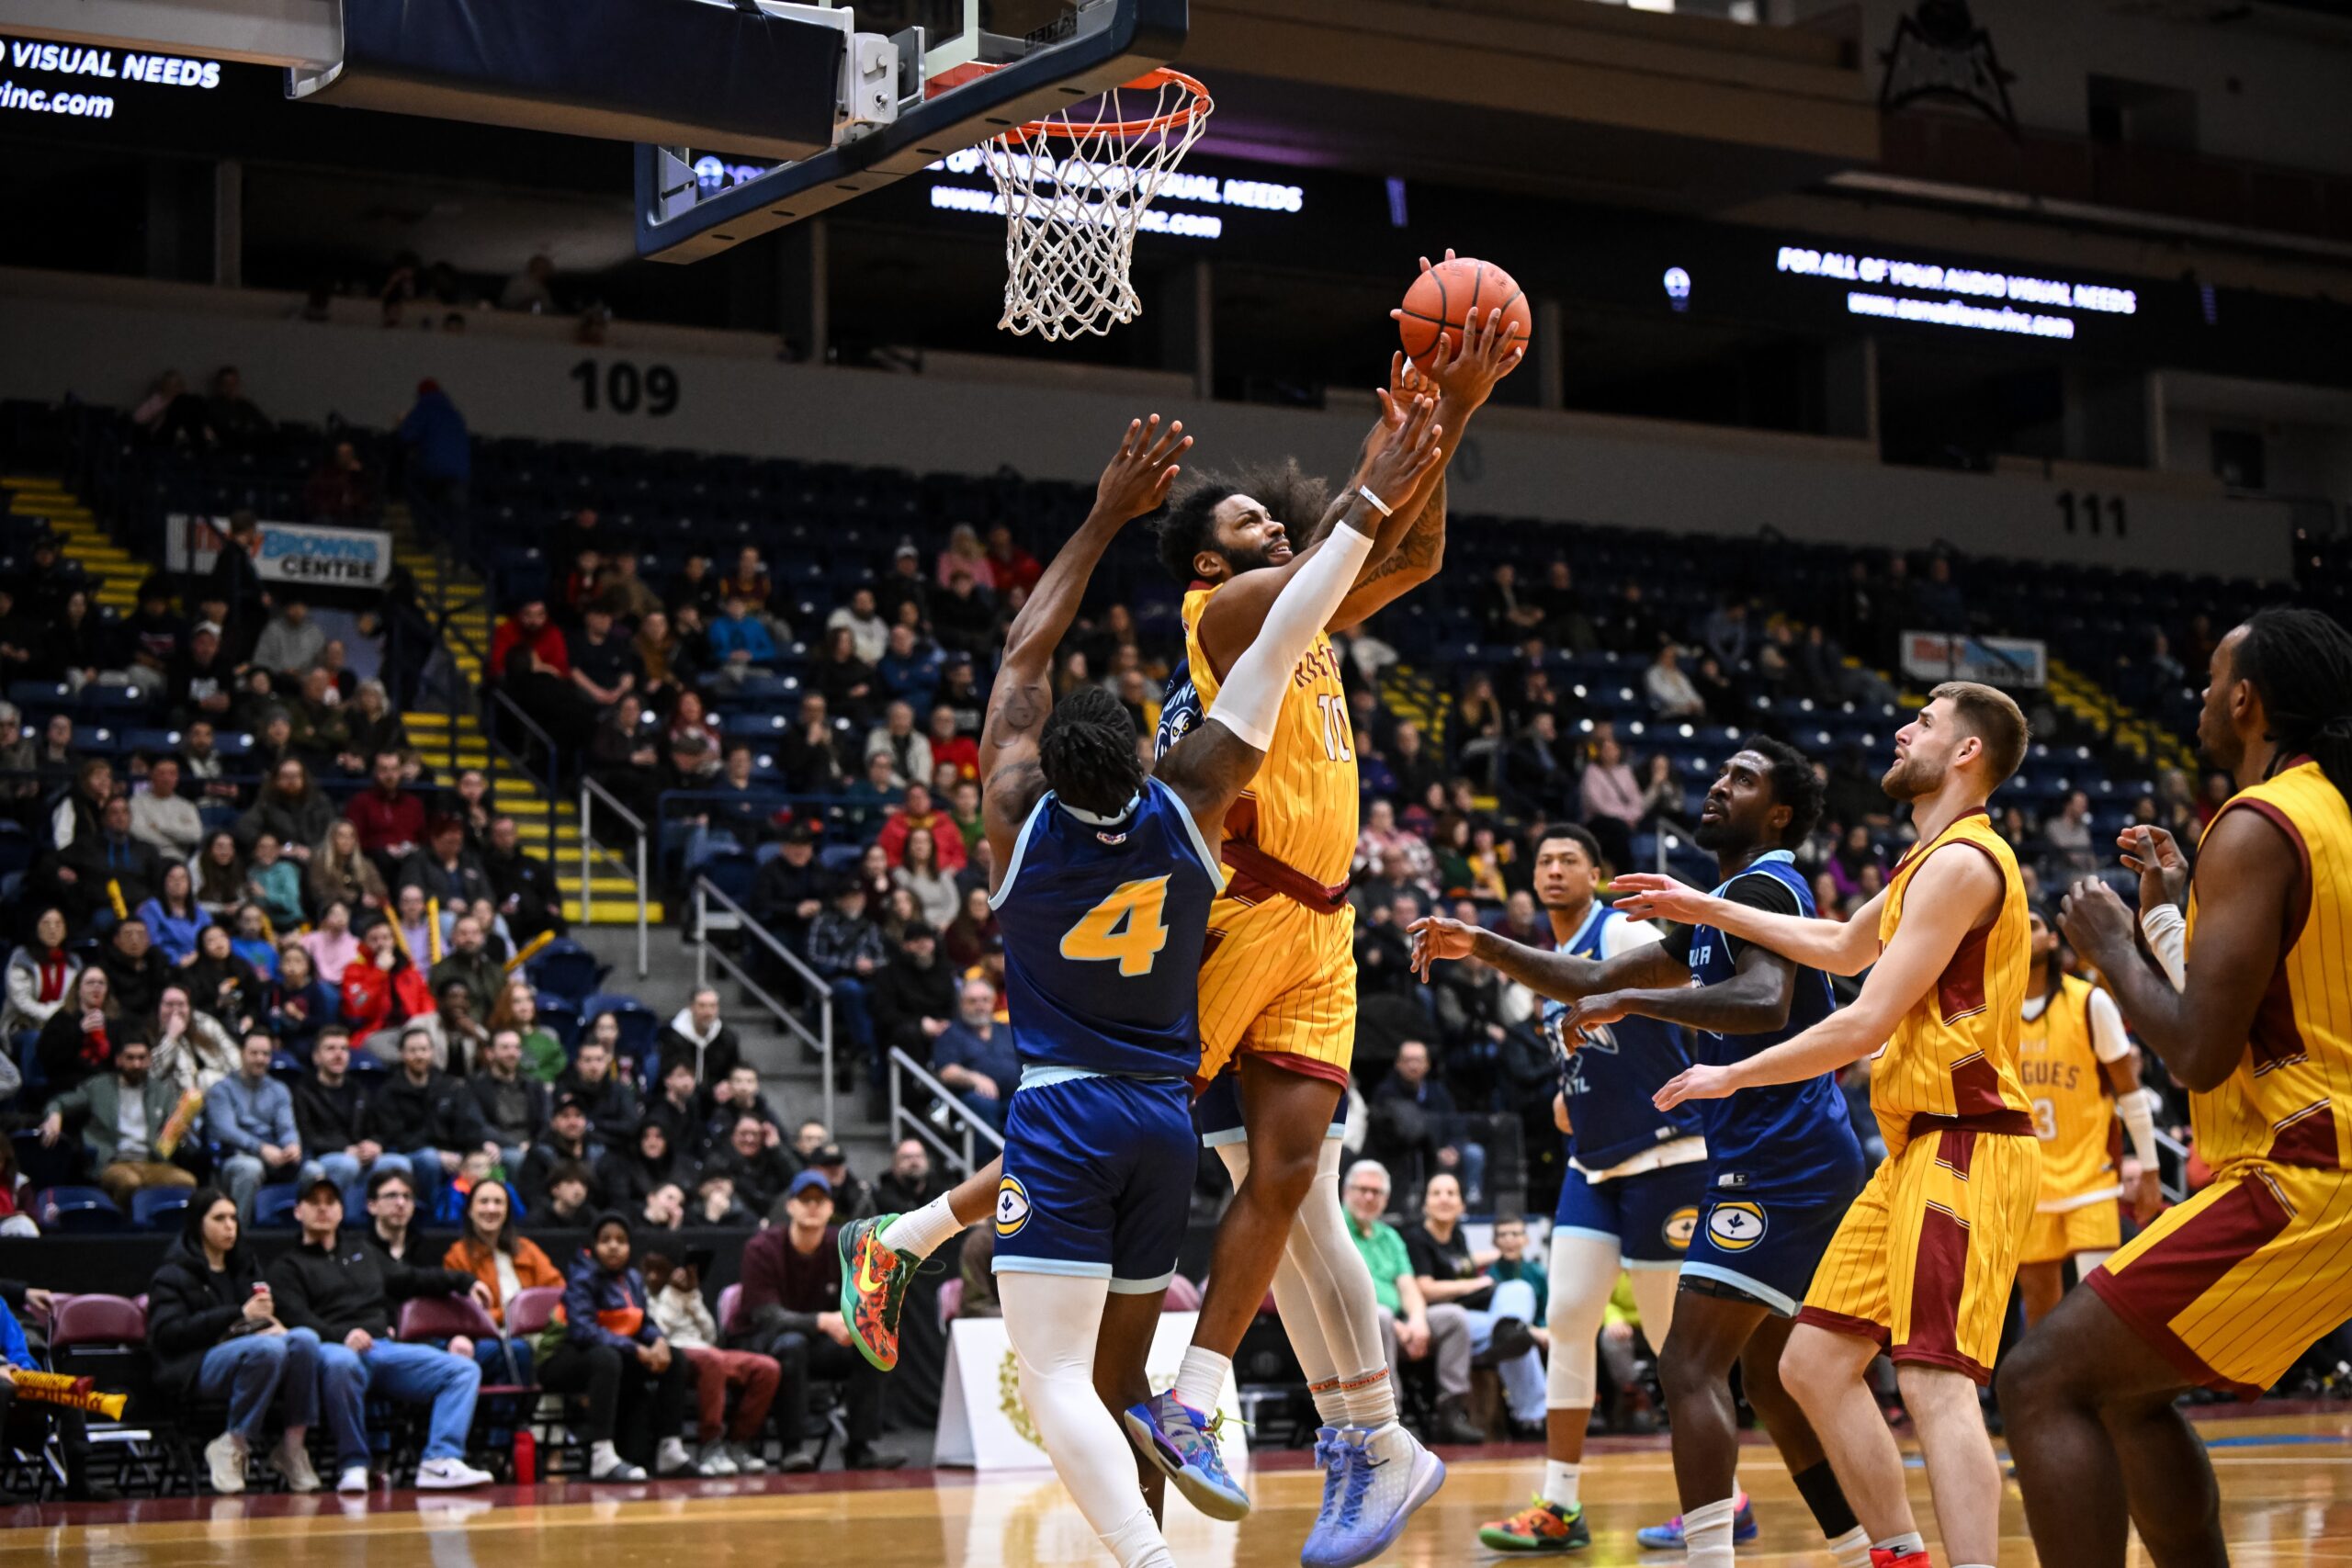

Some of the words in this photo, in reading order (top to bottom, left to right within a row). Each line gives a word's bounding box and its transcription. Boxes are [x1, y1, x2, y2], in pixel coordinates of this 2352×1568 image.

[12, 40, 117, 78] VISUAL
[121, 53, 221, 89] NEEDS
[1223, 179, 1303, 212] NEEDS
[1777, 246, 1822, 275] FOR
[1820, 252, 1860, 280] ALL
[1859, 257, 1890, 283] OF
[1888, 260, 1945, 290] YOUR
[1943, 267, 2007, 299] AUDIO
[2007, 276, 2074, 308] VISUAL
[2074, 283, 2137, 314] NEEDS
[571, 356, 680, 418] 109
[2055, 489, 2127, 538] 111
[280, 554, 376, 580] CENTRE
[1317, 693, 1351, 763] 10
[1059, 873, 1173, 978] 4
